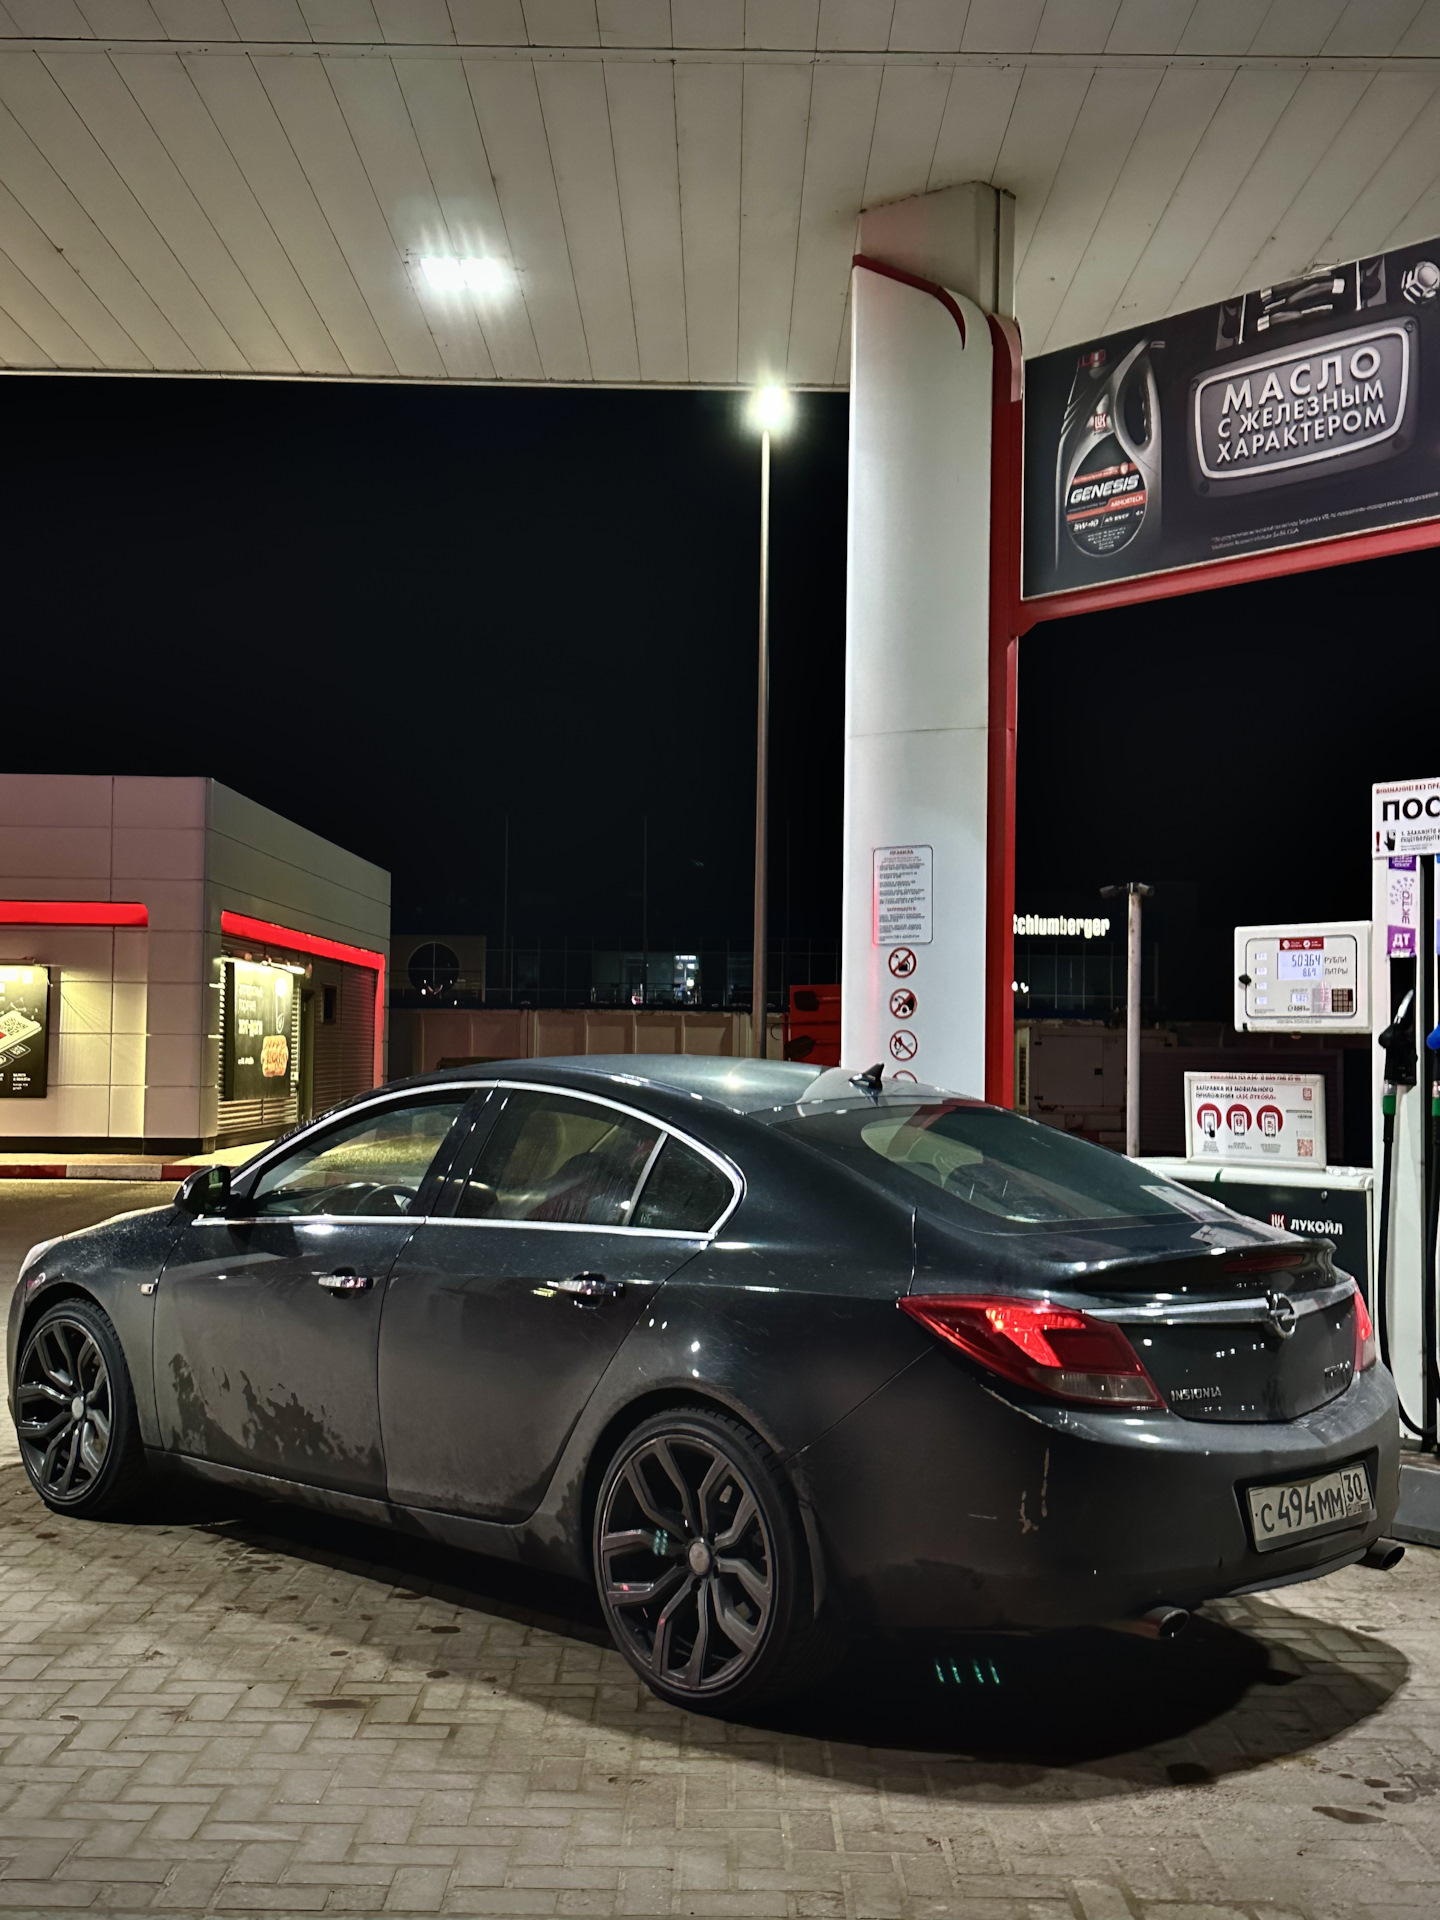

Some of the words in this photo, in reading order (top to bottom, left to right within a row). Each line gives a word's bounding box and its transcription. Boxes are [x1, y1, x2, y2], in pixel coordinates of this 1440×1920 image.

[1222, 346, 1381, 415] МАСЛО
[1218, 417, 1231, 439] С
[1239, 379, 1384, 434] ЖЕЛЕЗНЫМ
[1216, 404, 1386, 464] ХАРАКТЕРОМ
[1070, 474, 1140, 504] GENESIS
[1392, 933, 1411, 948] ДТ
[1291, 1219, 1343, 1235] ЛУКОЙЛ
